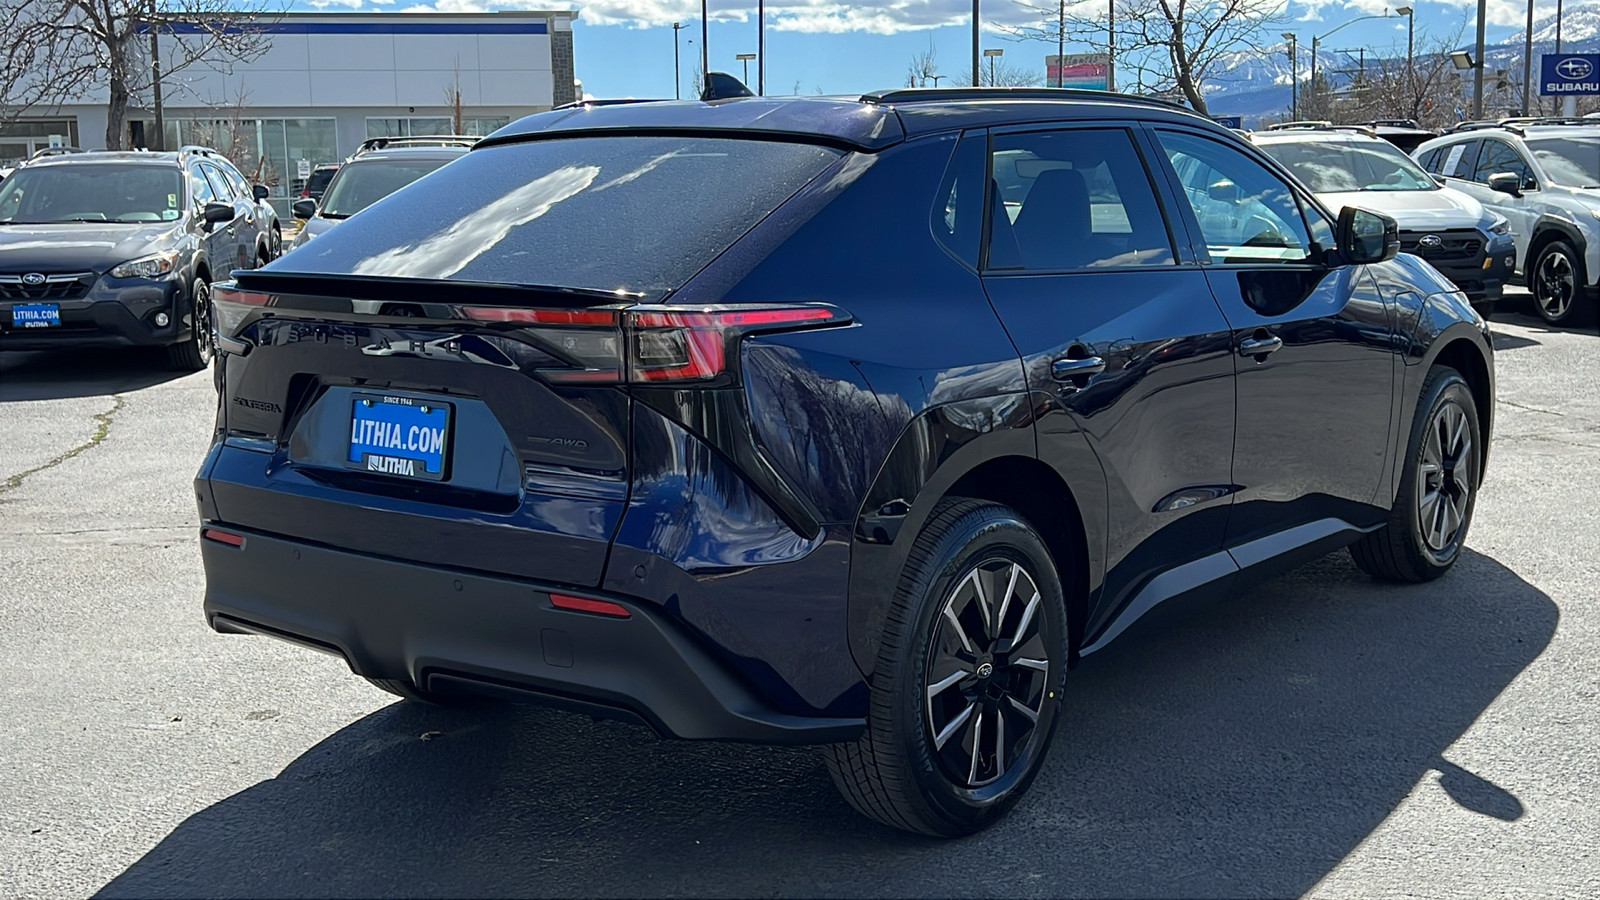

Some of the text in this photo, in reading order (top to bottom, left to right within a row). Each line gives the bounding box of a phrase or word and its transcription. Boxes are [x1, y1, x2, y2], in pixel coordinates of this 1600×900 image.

[1546, 82, 1599, 92] SUBARU
[13, 310, 59, 320] LITHIA.COM
[288, 328, 462, 355] SUBARU
[233, 396, 282, 414] SOLTERRA
[383, 396, 413, 406] SINCE 1946
[351, 418, 445, 455] LITHIA.COM
[378, 455, 415, 477] LITHIA
